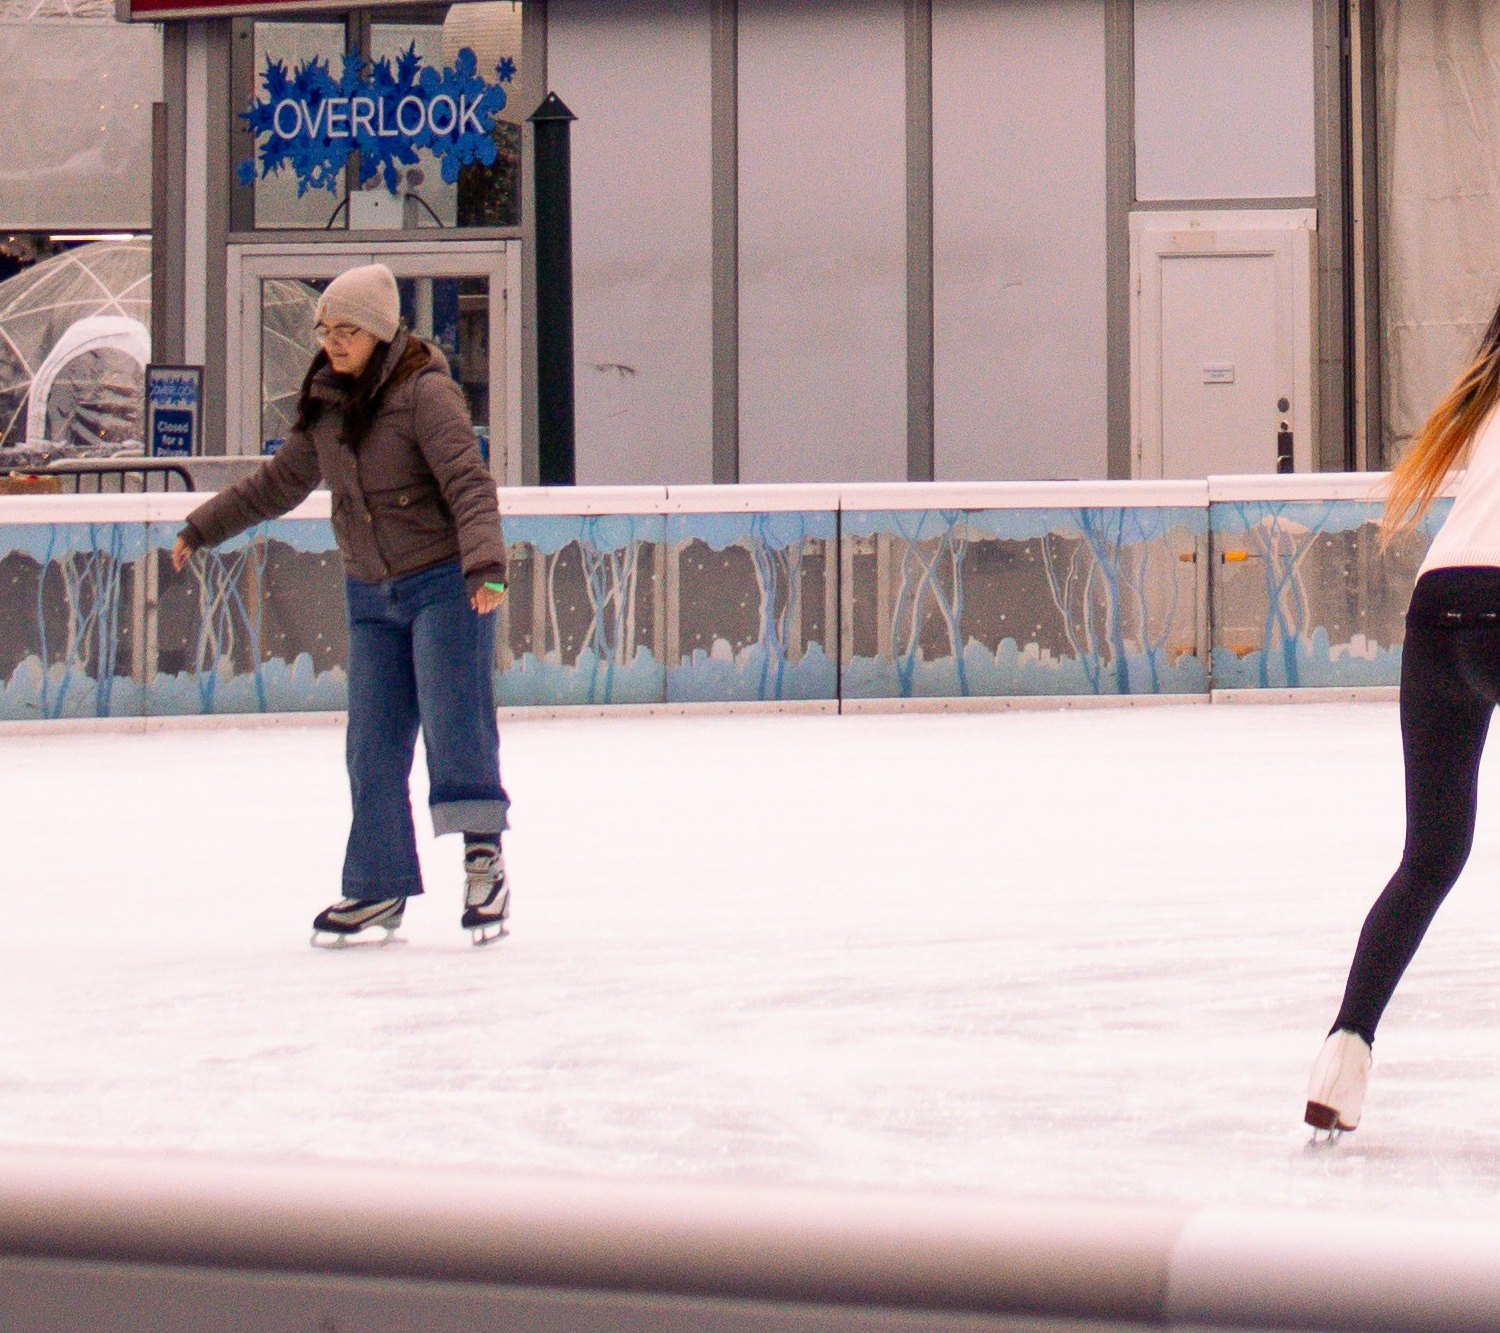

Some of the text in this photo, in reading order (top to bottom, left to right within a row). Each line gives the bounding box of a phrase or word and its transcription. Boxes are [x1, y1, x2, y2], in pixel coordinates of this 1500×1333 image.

[273, 93, 487, 140] OVERLOOK
[157, 421, 189, 433] Closed
[161, 434, 176, 446] for
